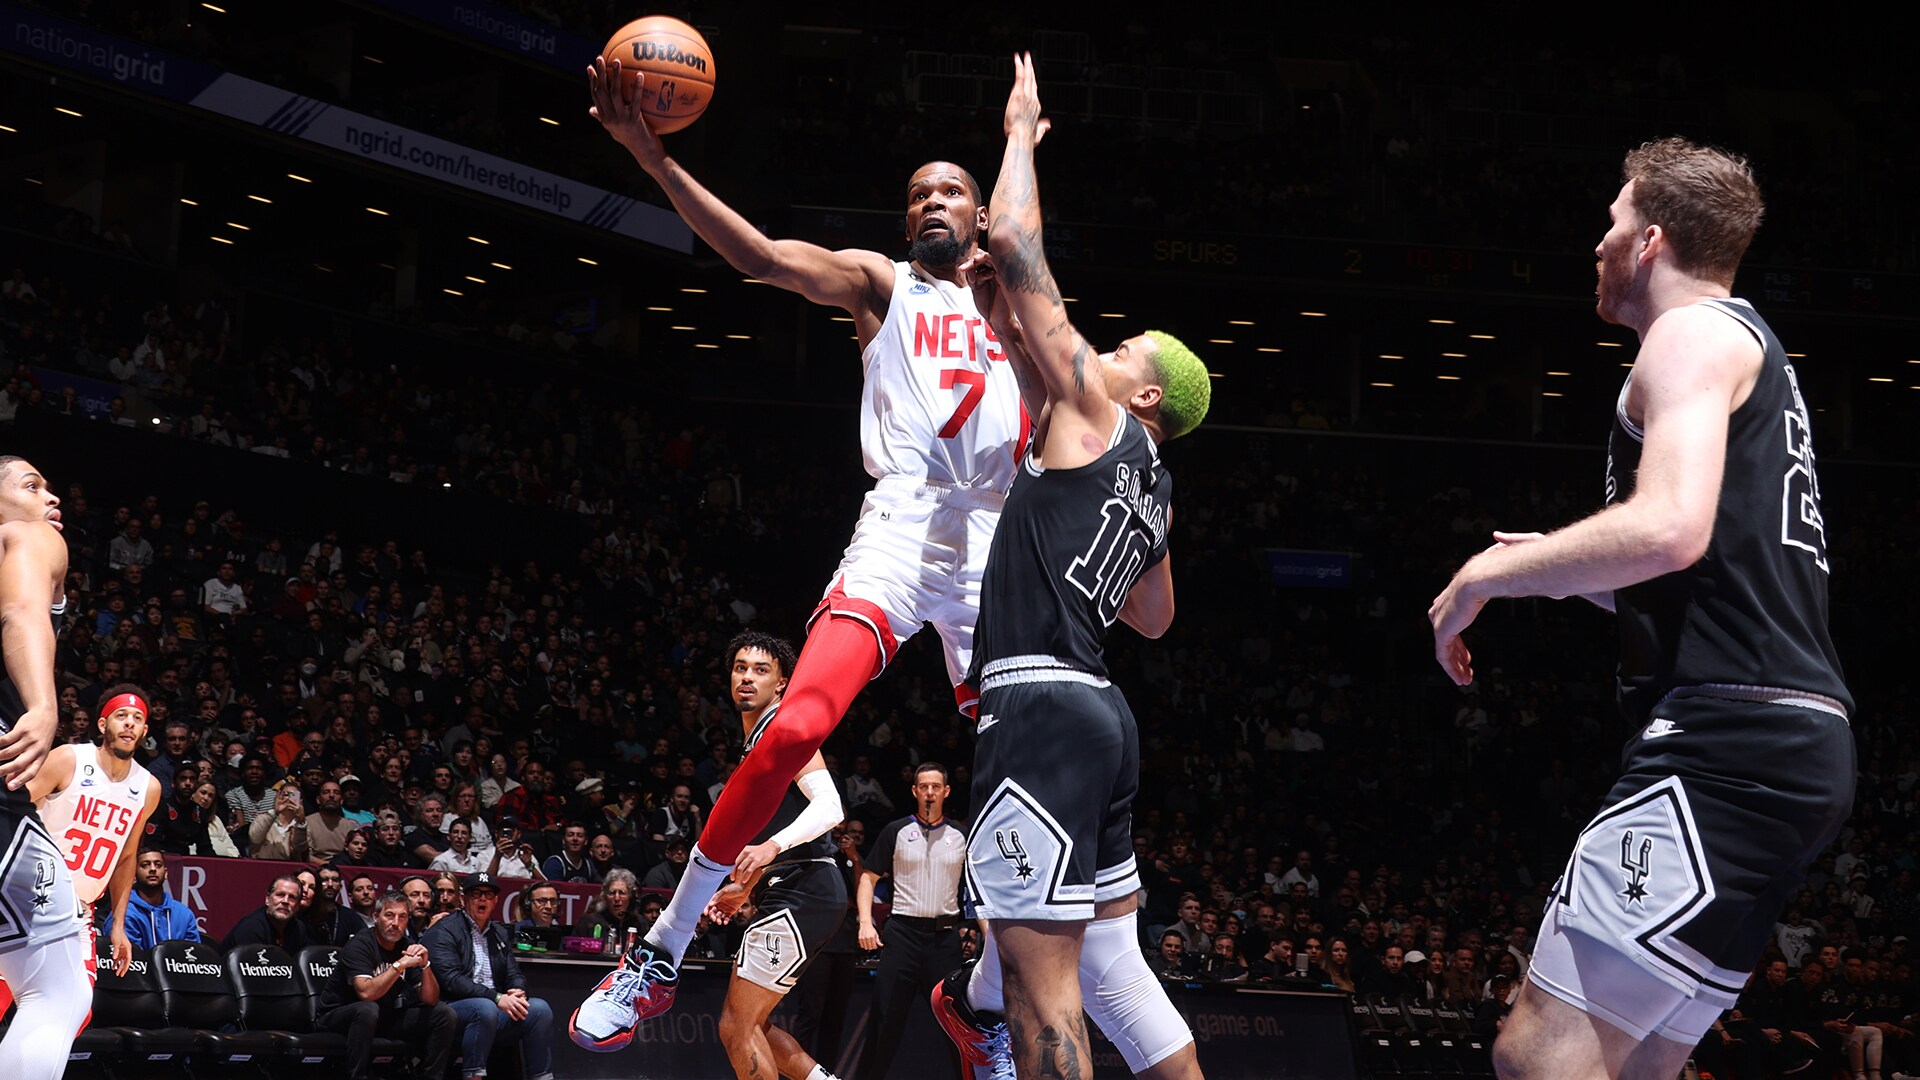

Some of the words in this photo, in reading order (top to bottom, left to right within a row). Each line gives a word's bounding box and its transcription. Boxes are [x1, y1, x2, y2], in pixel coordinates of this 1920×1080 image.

[454, 6, 556, 55] nationalgrid
[15, 23, 165, 86] nationalgrid
[632, 41, 706, 75] Wilson
[345, 125, 572, 213] ngrid.com/heretohelp
[1153, 240, 1238, 265] SPURS
[1344, 249, 1362, 274] 2
[1511, 258, 1532, 284] 4
[913, 312, 1008, 362] NETS
[938, 369, 986, 438] 7
[1065, 497, 1150, 628] 10
[1273, 564, 1344, 579] nationalgrid
[73, 794, 132, 836] NETS
[64, 828, 118, 880] 30
[164, 957, 222, 978] Hennessy
[239, 962, 293, 979] Hennessy
[1195, 1013, 1249, 1042] game
[1254, 1014, 1285, 1037] on.
